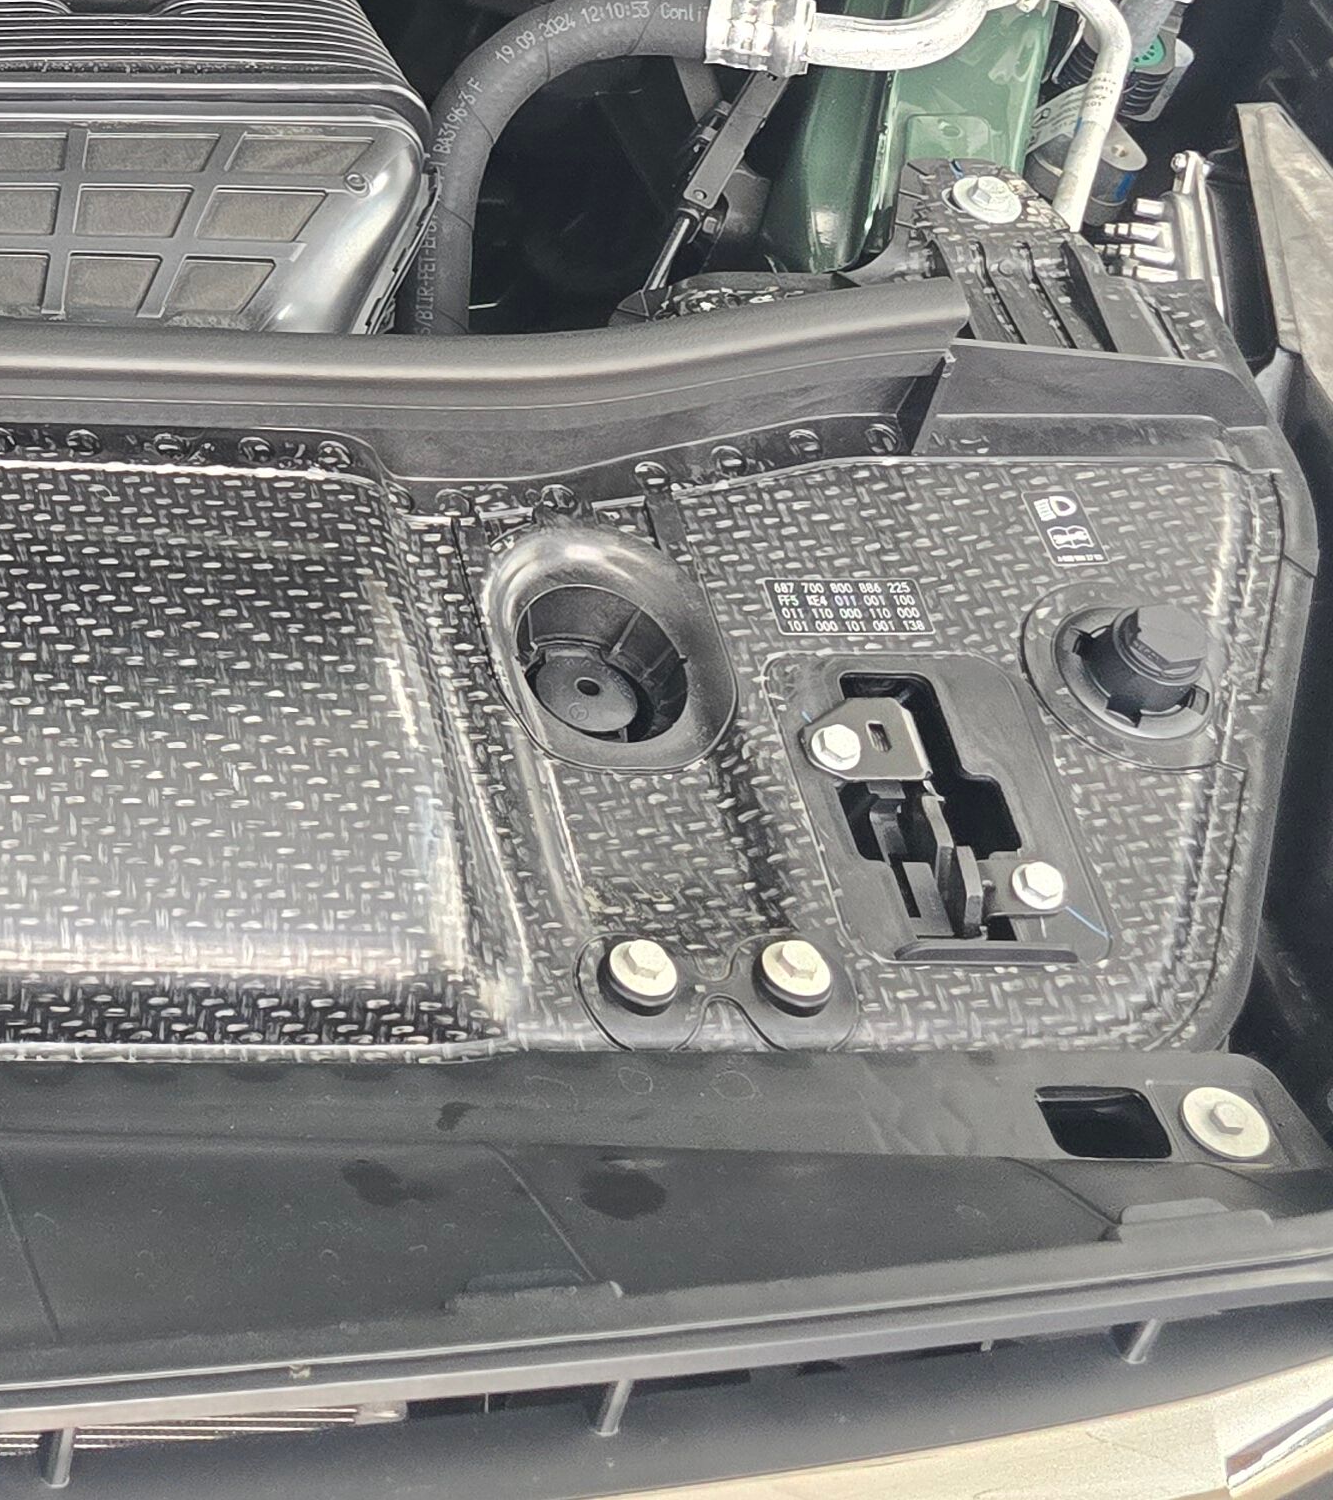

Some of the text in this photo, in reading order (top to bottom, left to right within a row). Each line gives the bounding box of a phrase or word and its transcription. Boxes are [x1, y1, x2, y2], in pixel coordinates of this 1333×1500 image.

[494, 11, 577, 65] 19.09.2024
[580, 0, 650, 26] 12:10:53
[801, 582, 824, 594] 700
[887, 582, 910, 594] 225
[778, 595, 915, 606] FF5 KE4 011 001 100
[781, 607, 920, 619] 011 110 000 110 000
[787, 620, 925, 632] 101 000 101 001 138
